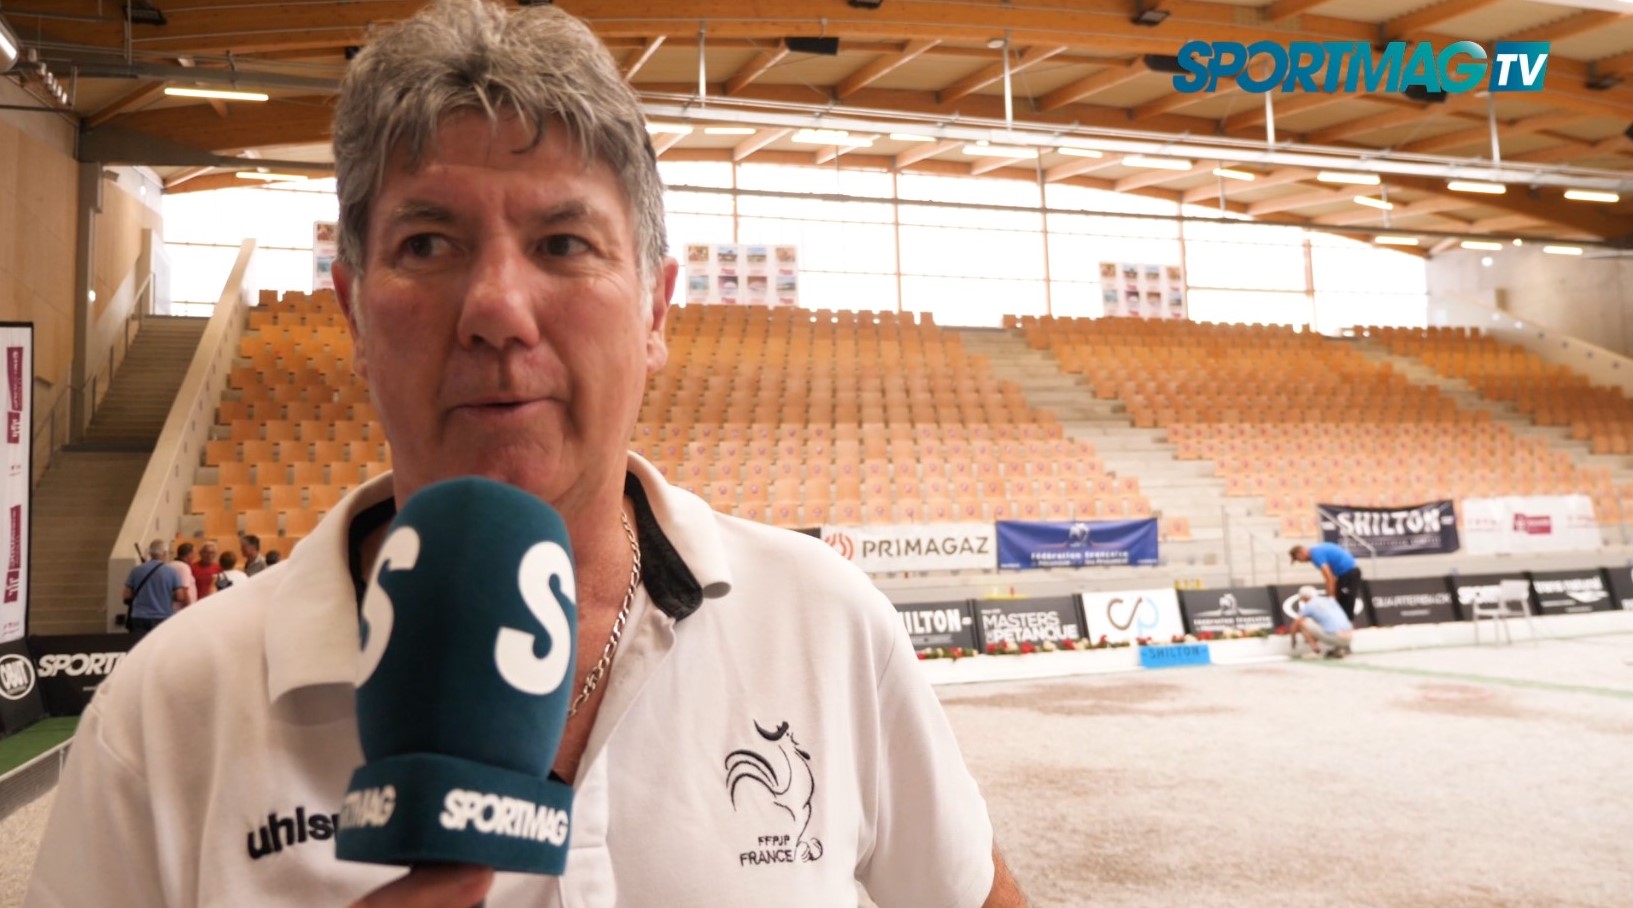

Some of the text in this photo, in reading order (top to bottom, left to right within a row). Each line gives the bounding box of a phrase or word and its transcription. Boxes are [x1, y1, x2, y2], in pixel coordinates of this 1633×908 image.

[1337, 508, 1440, 536] SHILTON
[862, 536, 989, 560] PRIMAGAZ
[495, 541, 576, 695] S
[982, 611, 1060, 630] MASTERS
[1150, 645, 1200, 660] SHILTON
[439, 788, 569, 846] SPORTMAG
[758, 834, 790, 846] FFPJP
[740, 849, 794, 867] FRANCE
